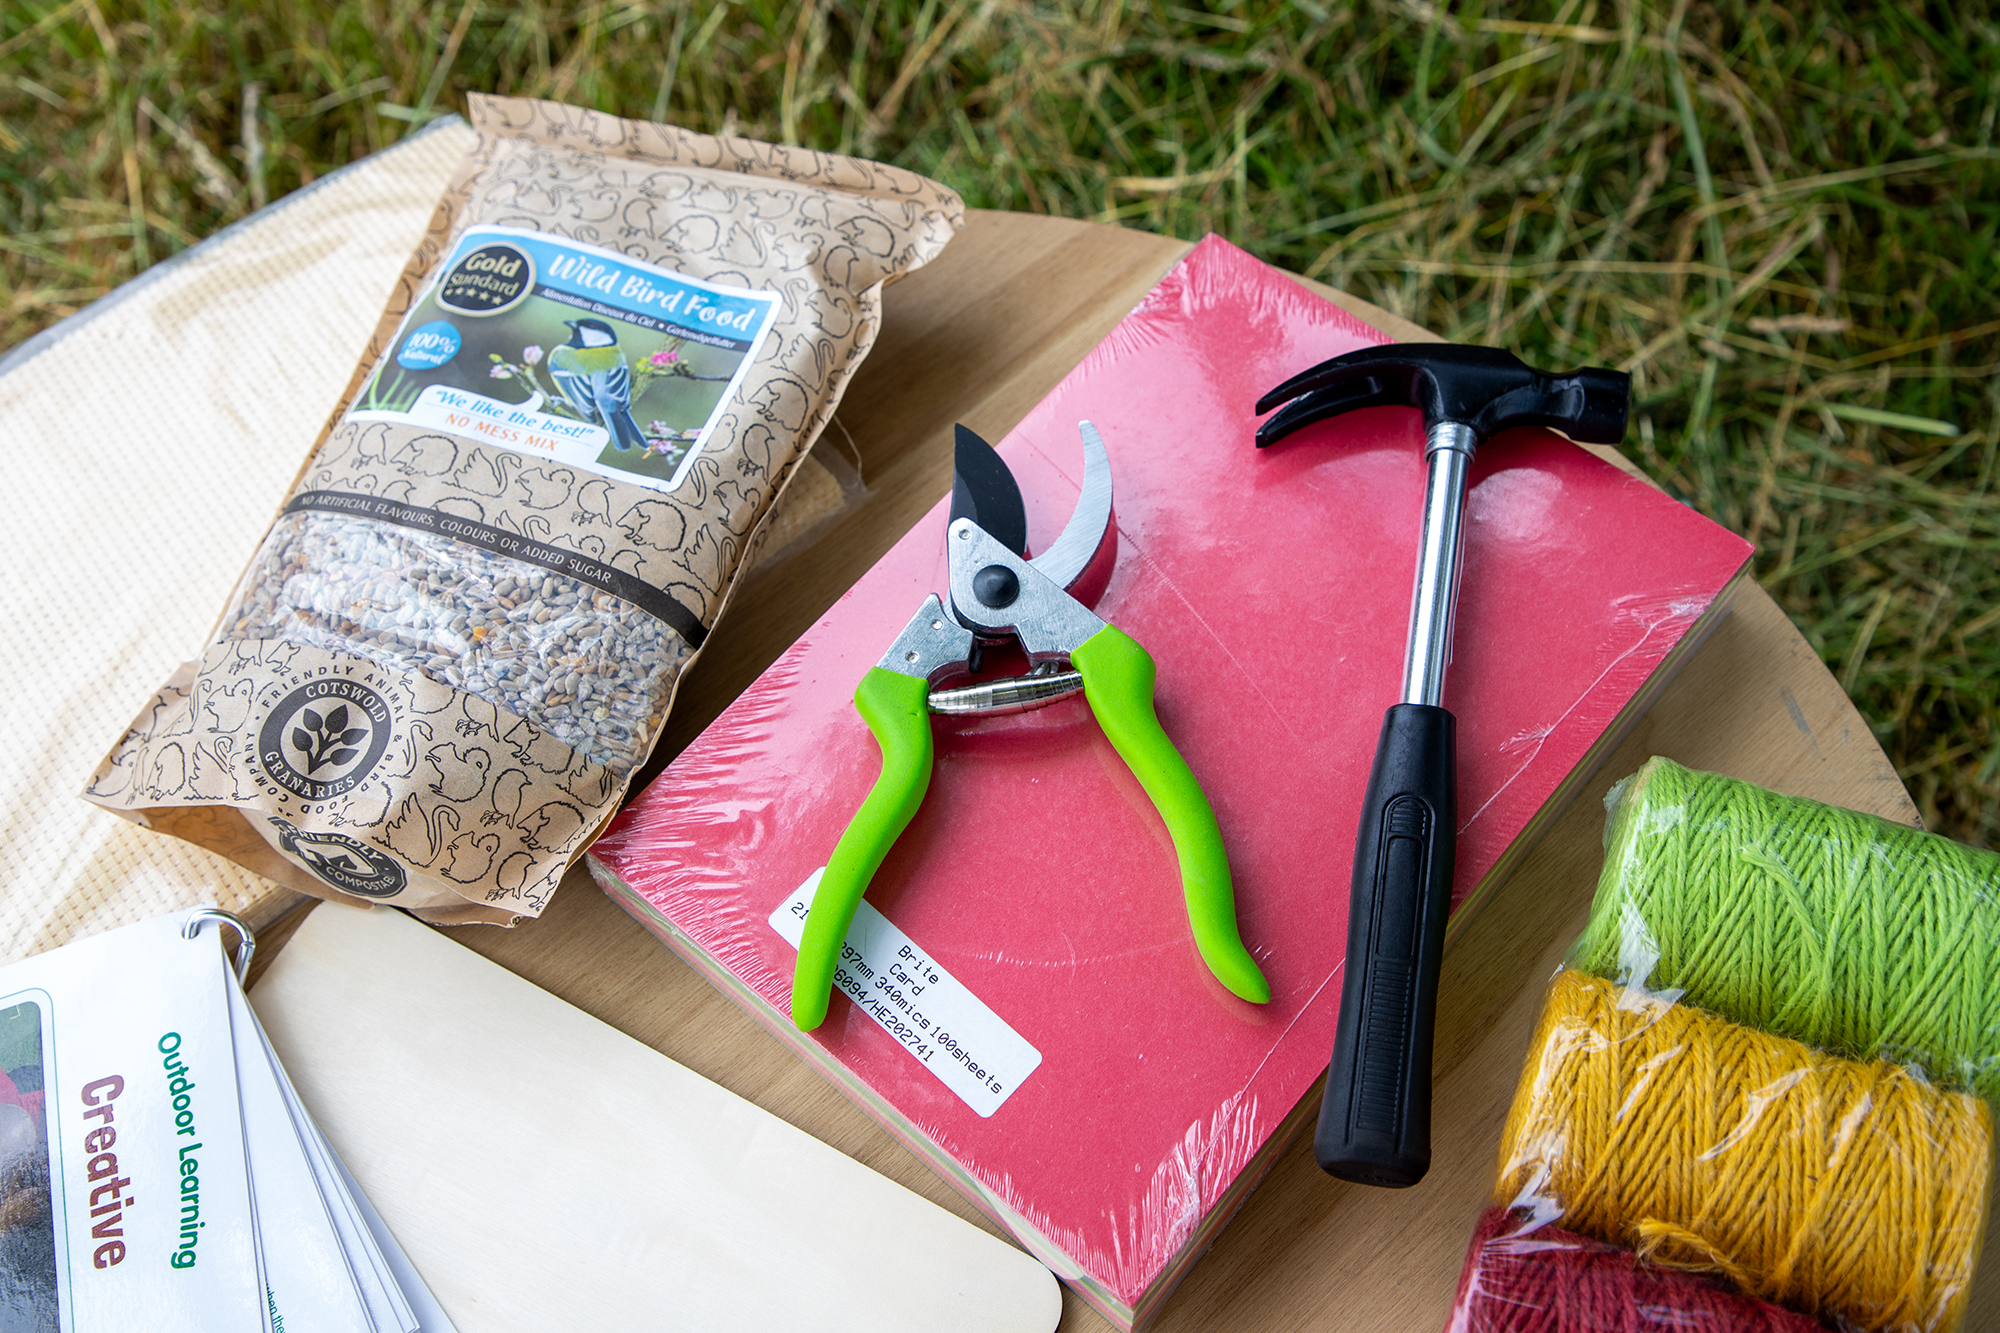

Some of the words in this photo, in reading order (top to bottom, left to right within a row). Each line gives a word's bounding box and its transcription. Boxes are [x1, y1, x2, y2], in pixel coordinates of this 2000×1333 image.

[465, 252, 522, 278] Gold
[541, 288, 592, 310] Alimentation
[624, 312, 638, 323] du
[637, 315, 657, 328] Ciel
[549, 253, 622, 294] Wild
[620, 275, 685, 312] Bird
[683, 294, 756, 332] Food
[397, 348, 448, 365] Natural
[408, 332, 458, 354] 100%
[445, 413, 470, 428] NO
[474, 422, 521, 443] MESS
[524, 435, 560, 452] MIX
[470, 397, 504, 419] like
[508, 410, 538, 427] the
[299, 495, 315, 506] NO
[314, 494, 371, 512] ARTIFICIAL
[375, 503, 436, 527] FLAVOURS,
[439, 519, 498, 544] COLOURS
[499, 537, 519, 552] OR
[520, 544, 565, 566] ADDED
[566, 558, 612, 584] SUGAR
[261, 664, 355, 709] FRIENDLY
[305, 682, 387, 723] COTSWOLD
[363, 672, 405, 724] ANIMAL
[244, 732, 289, 803] COMPANY
[264, 751, 355, 798] GRANARIES
[360, 754, 394, 792] BIRD
[300, 795, 348, 814] FOOD
[325, 866, 396, 891] COMPOSTAB
[889, 963, 925, 996] Card
[897, 945, 939, 985] Brite
[791, 902, 809, 920] 21
[874, 976, 930, 1029] 340mics
[929, 1026, 1003, 1095] 100sheets
[833, 964, 935, 1062] 6094/HE202741
[157, 1031, 196, 1136] Outdoor
[81, 1074, 135, 1269] Creative
[170, 1141, 206, 1269] Learning
